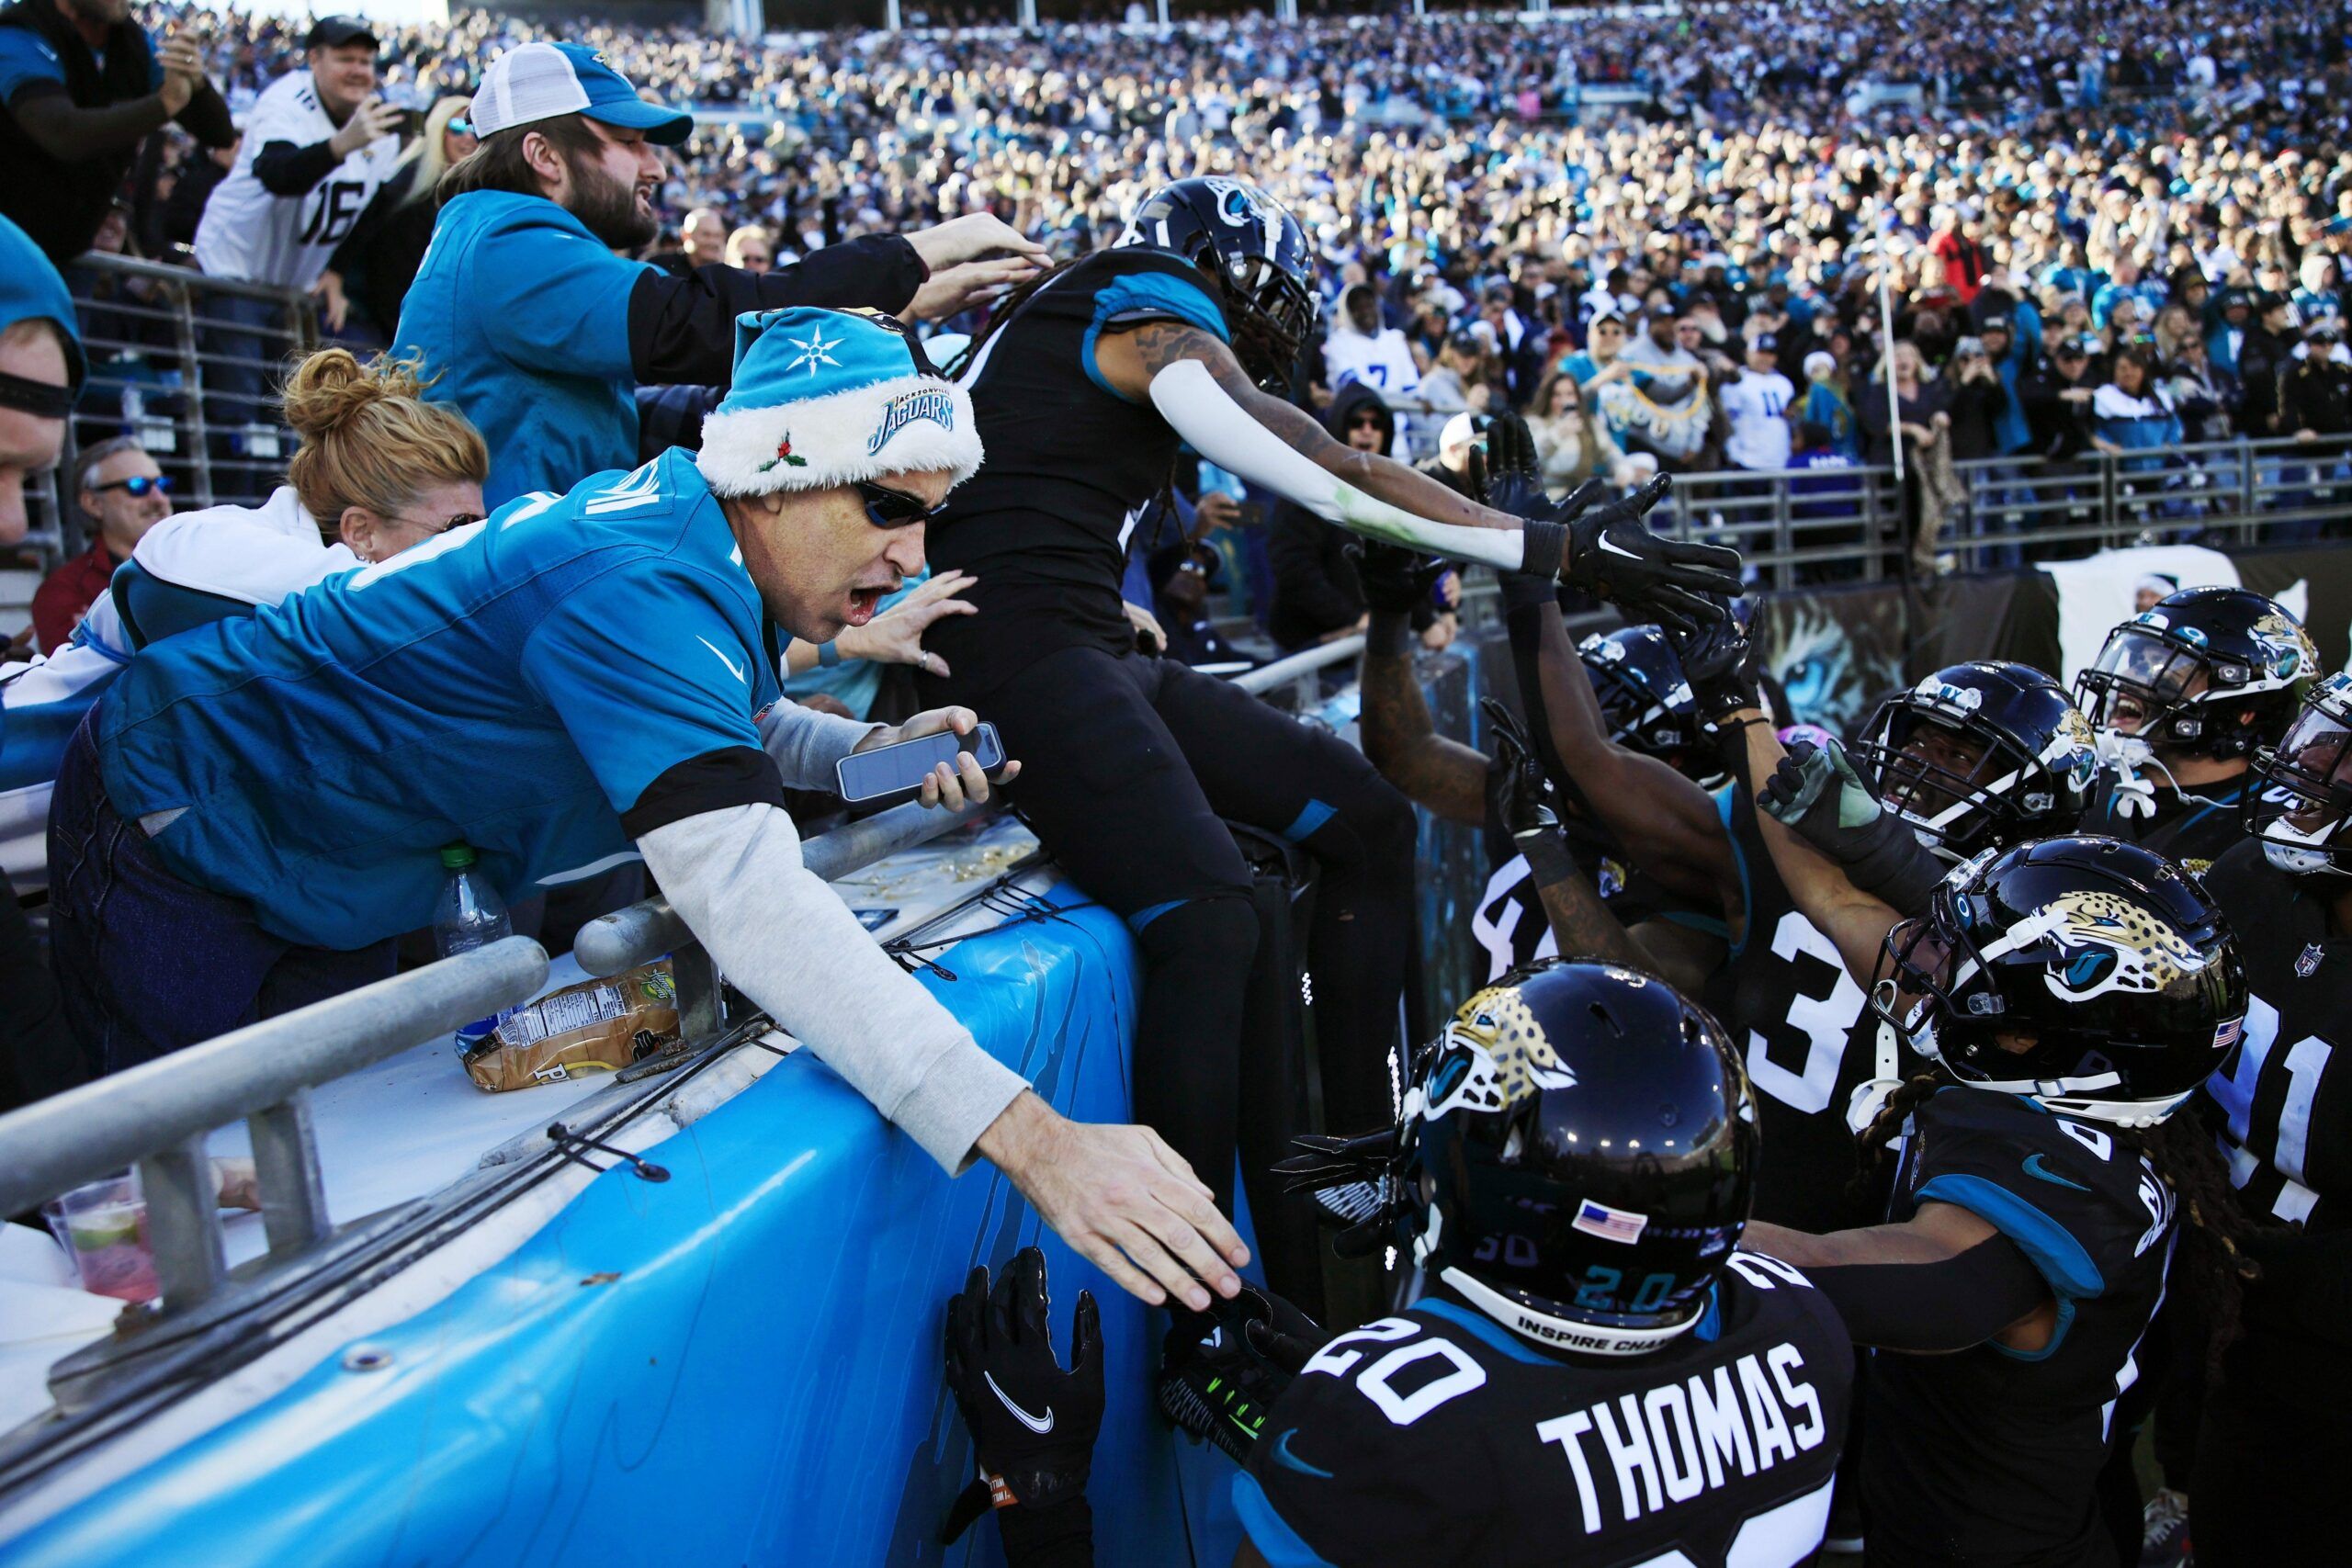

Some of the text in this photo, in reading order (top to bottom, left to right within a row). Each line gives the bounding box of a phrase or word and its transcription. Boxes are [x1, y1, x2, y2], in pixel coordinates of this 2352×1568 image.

[300, 181, 365, 246] 16
[867, 396, 954, 457] JAGUARS
[1575, 1264, 1676, 1313] 20
[1518, 1315, 1611, 1351] INSPIRE
[1301, 1317, 1487, 1426] 20
[1536, 1342, 1826, 1535] THOMAS
